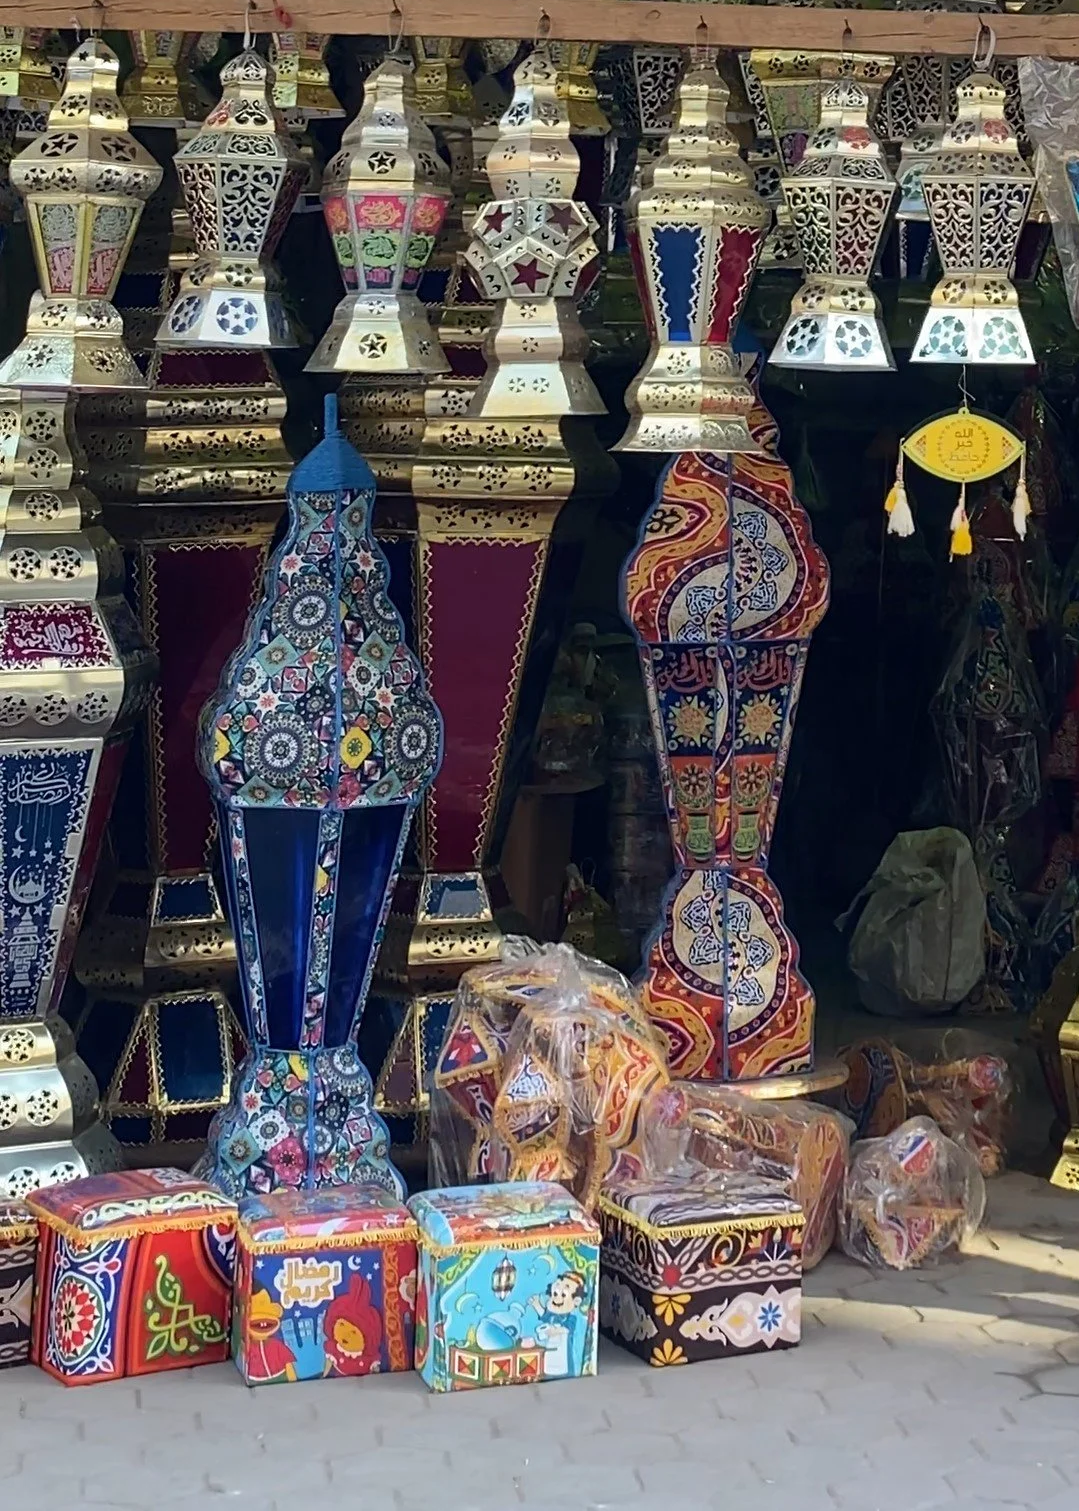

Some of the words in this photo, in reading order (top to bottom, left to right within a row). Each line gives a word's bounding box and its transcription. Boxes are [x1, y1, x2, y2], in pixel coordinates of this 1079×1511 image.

[954, 428, 974, 438] الله
[280, 1261, 340, 1291] رمضان
[283, 1279, 332, 1305] كريم
